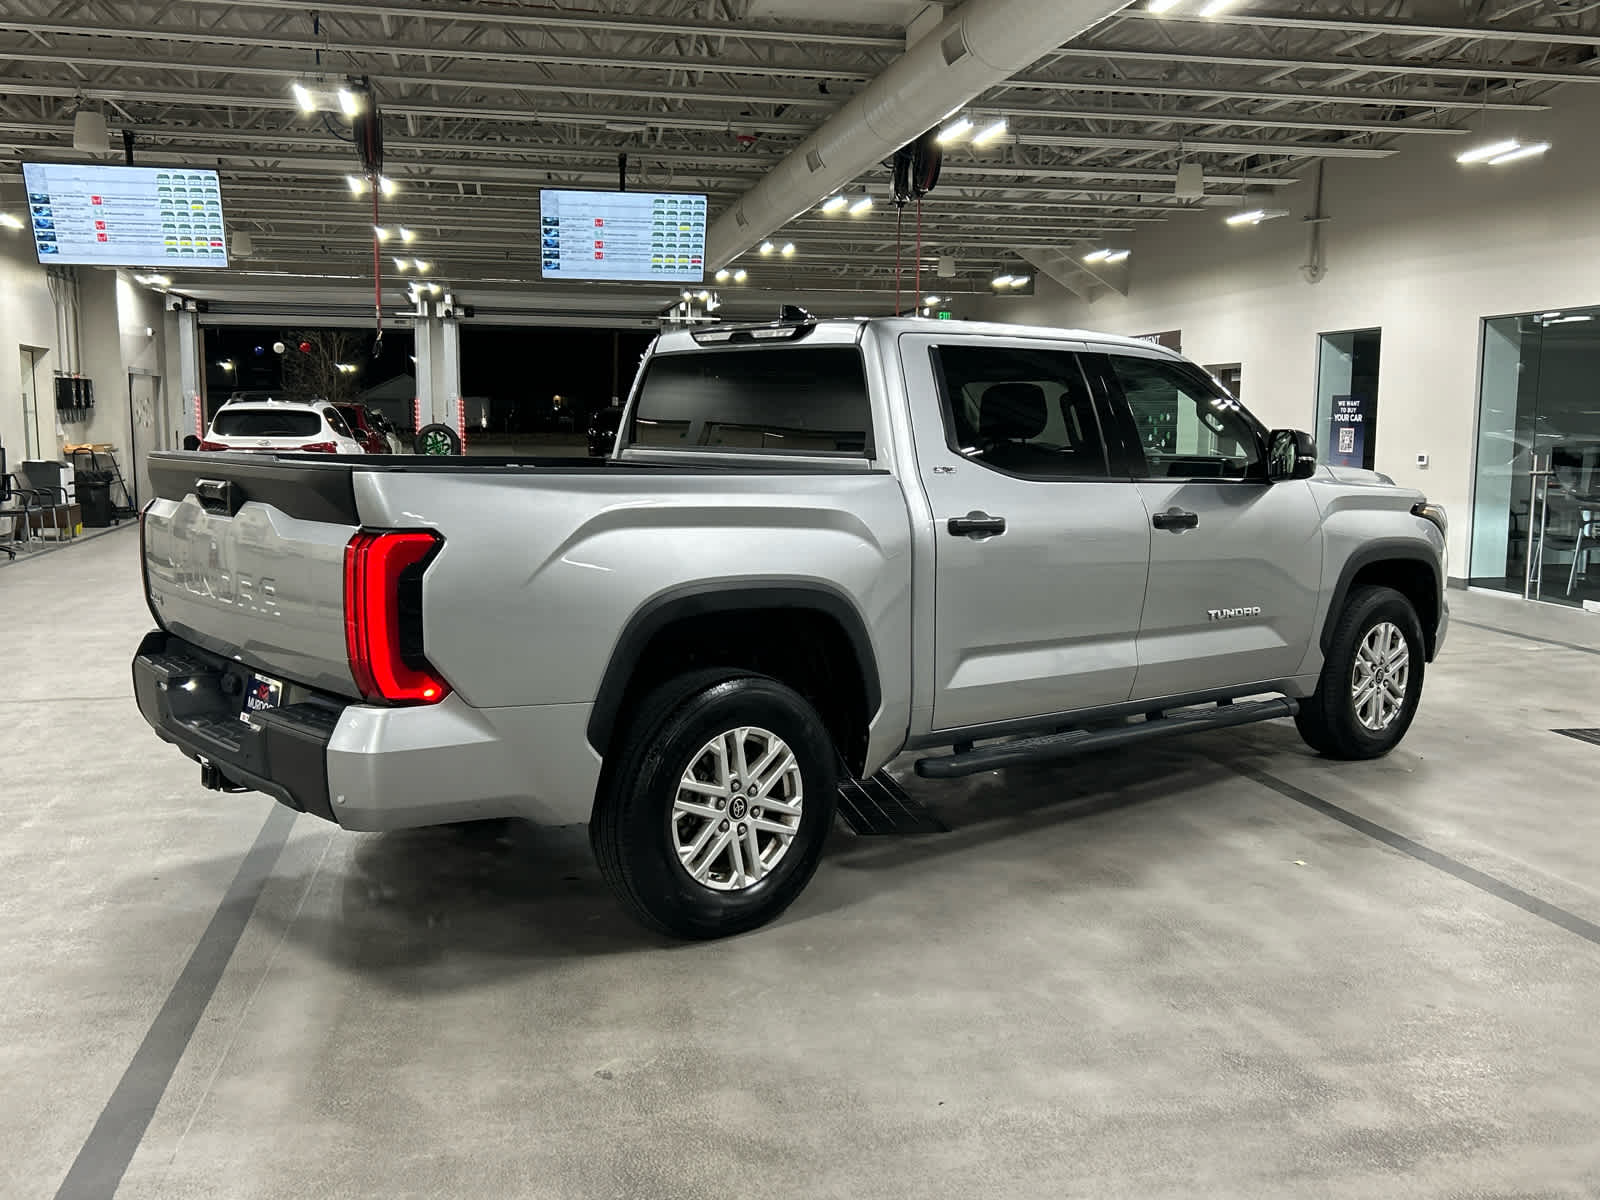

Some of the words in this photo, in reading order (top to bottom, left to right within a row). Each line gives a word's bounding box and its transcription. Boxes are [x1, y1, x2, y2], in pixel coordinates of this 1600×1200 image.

[1334, 414, 1350, 422] YOUR
[1350, 414, 1362, 422] CAR
[1207, 606, 1262, 620] TUNDRA
